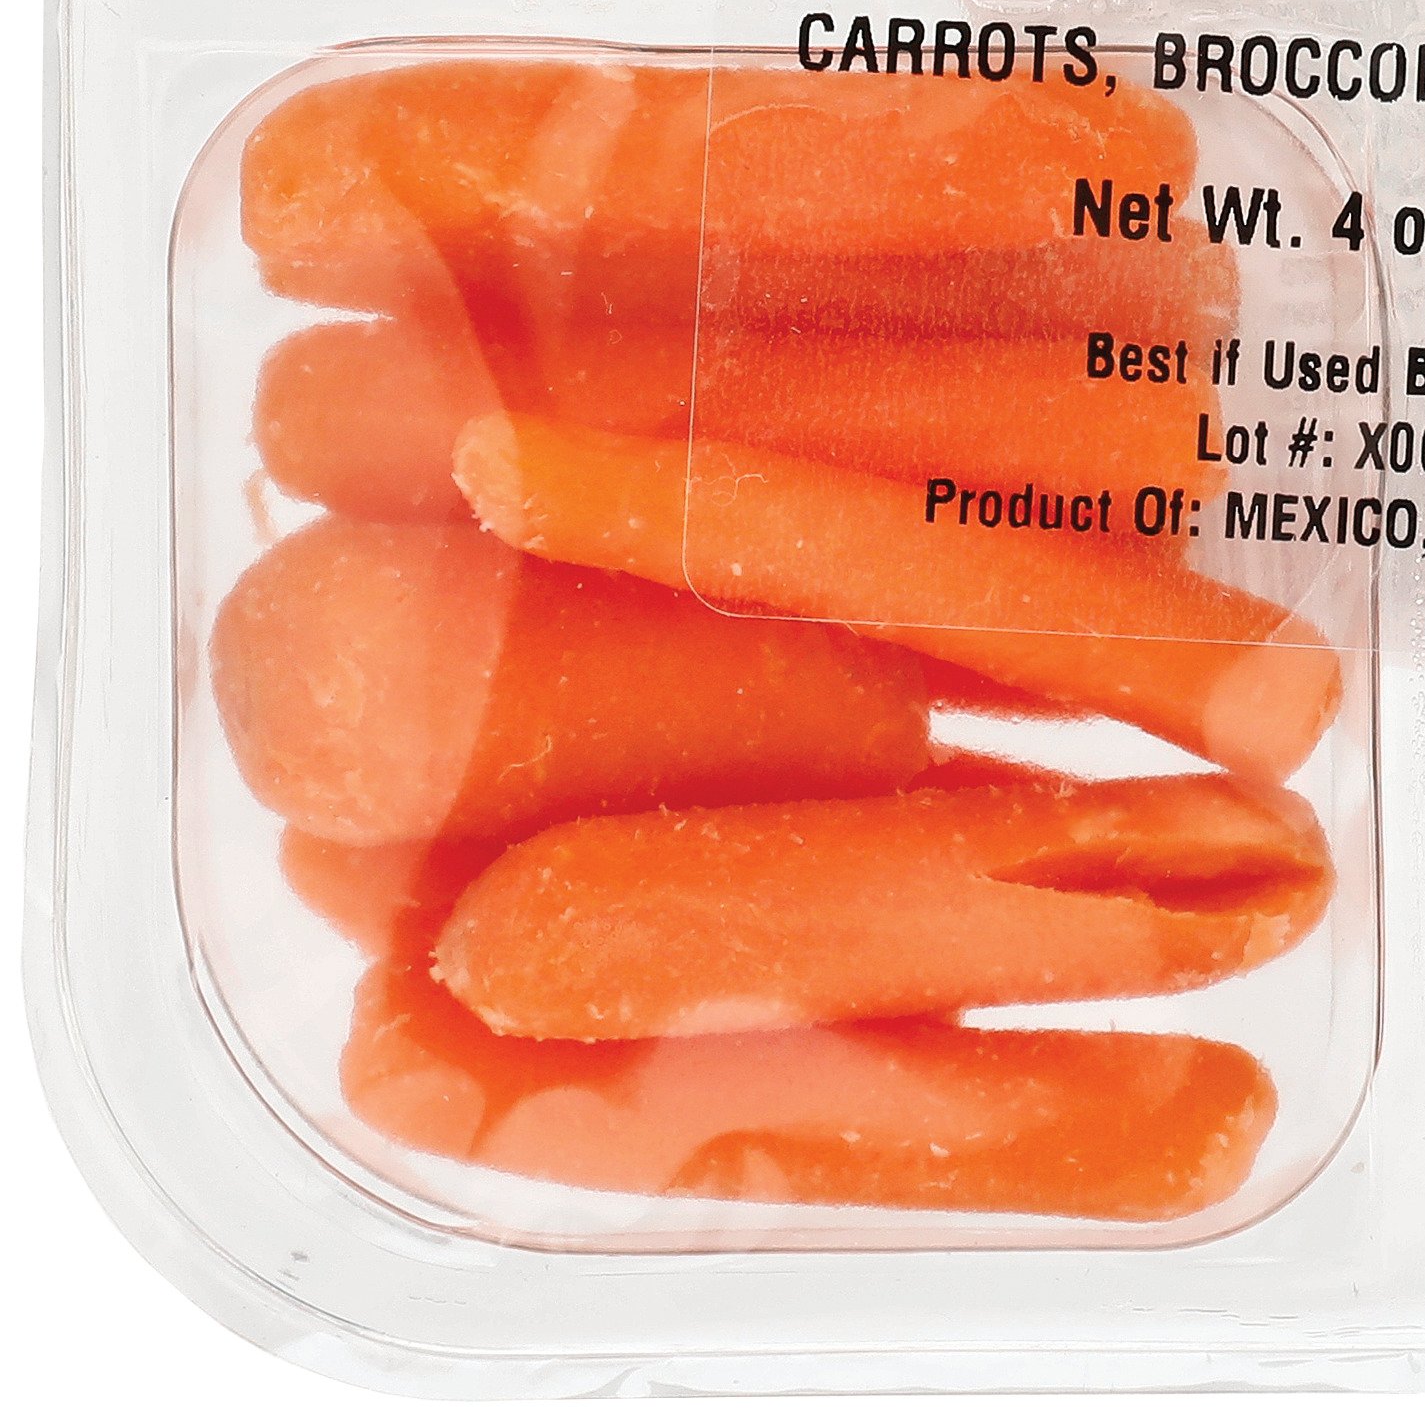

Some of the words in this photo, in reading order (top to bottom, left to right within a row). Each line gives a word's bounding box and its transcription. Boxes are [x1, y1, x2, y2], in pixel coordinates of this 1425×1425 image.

[799, 13, 1118, 97] CARROTS,
[1073, 178, 1173, 242] Net
[1202, 184, 1301, 248] Wt.
[1332, 190, 1365, 251] 4
[1086, 332, 1188, 384] Best
[1212, 338, 1240, 385] if
[1263, 340, 1380, 394] Used
[1197, 413, 1268, 465] Lot
[1288, 417, 1334, 468] #:
[925, 478, 1112, 533] Product
[1133, 486, 1200, 537] Of:
